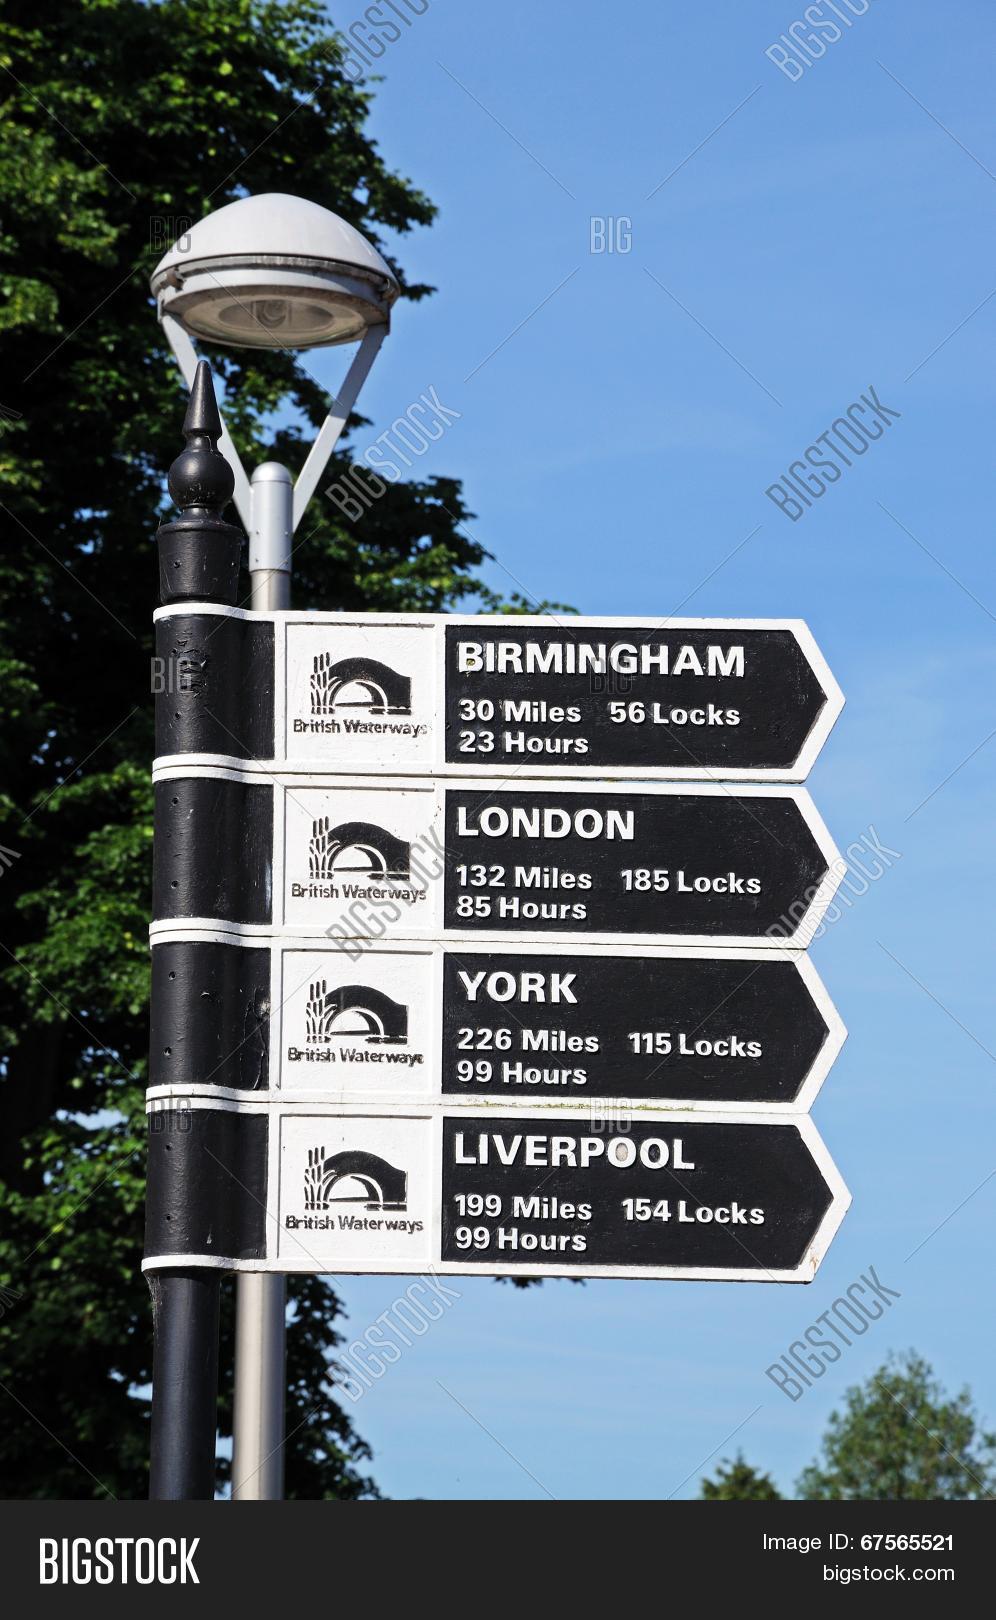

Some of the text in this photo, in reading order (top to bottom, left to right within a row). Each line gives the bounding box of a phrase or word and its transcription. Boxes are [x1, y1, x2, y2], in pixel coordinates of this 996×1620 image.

[456, 641, 745, 678] BIRMINGHAM
[458, 698, 741, 726] 30 Miles 56 Locks
[293, 718, 428, 738] British Waterways
[459, 730, 589, 754] 23 Hours
[457, 806, 635, 840] LONDON
[455, 864, 762, 894] 132 Miles 185 Locks
[291, 883, 427, 903] British Waterways
[455, 895, 587, 920] 85 Hours
[457, 970, 578, 1004] YORK
[287, 1046, 336, 1062] British
[457, 1027, 762, 1058] 226 Miles 115 Locks
[457, 1059, 587, 1085] 99 Hours
[455, 1133, 695, 1170] LIVERPOOL
[454, 1193, 765, 1225] 199 Miles 154 Locks
[285, 1214, 424, 1234] British Waterways
[455, 1226, 587, 1252] 99 Hours
